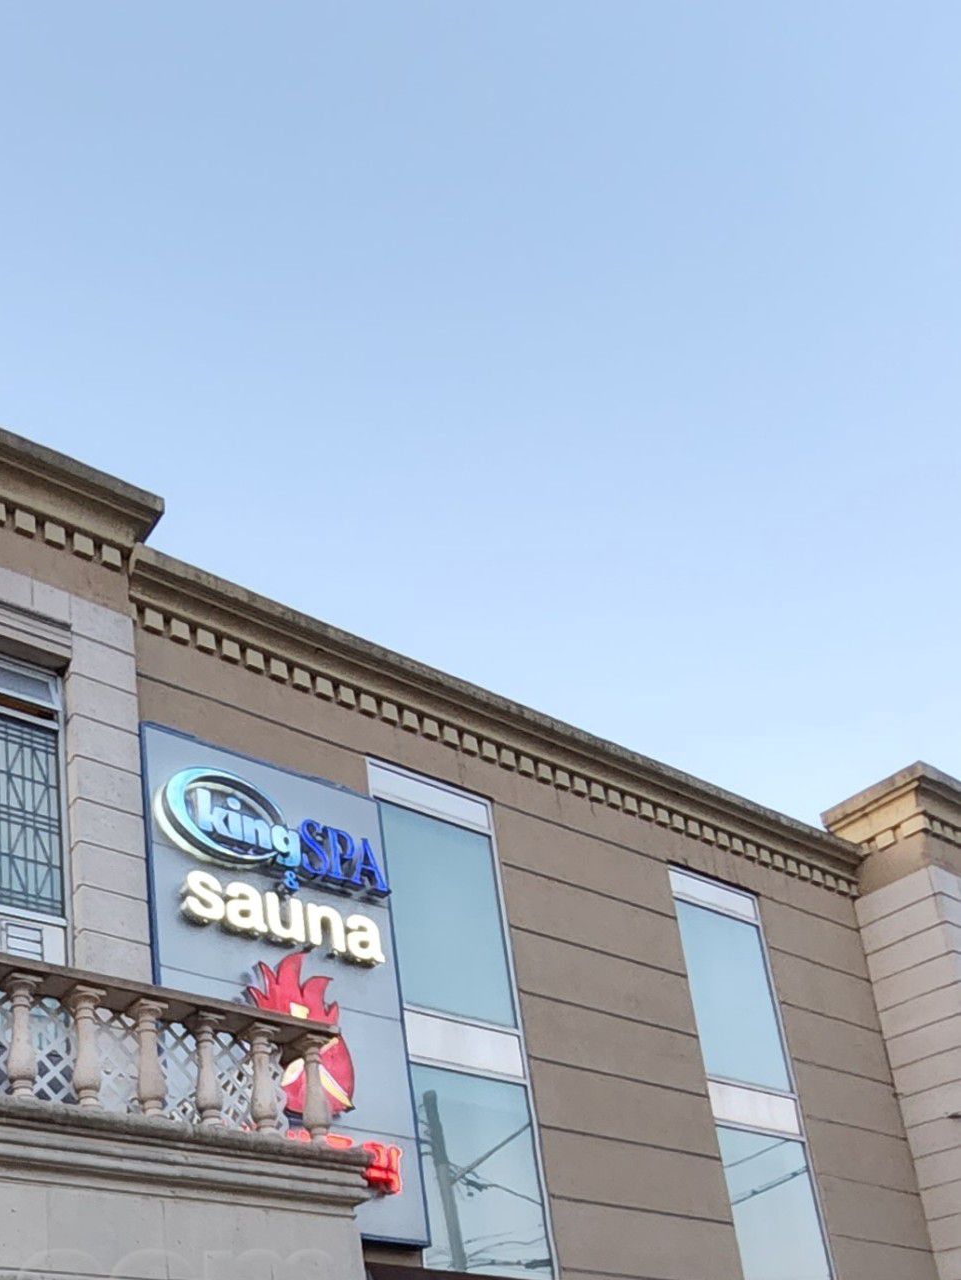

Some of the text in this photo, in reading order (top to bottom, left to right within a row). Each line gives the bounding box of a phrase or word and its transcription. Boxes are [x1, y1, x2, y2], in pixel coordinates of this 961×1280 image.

[196, 788, 391, 896] king SPA
[284, 869, 300, 892] &
[182, 869, 386, 965] sauna
